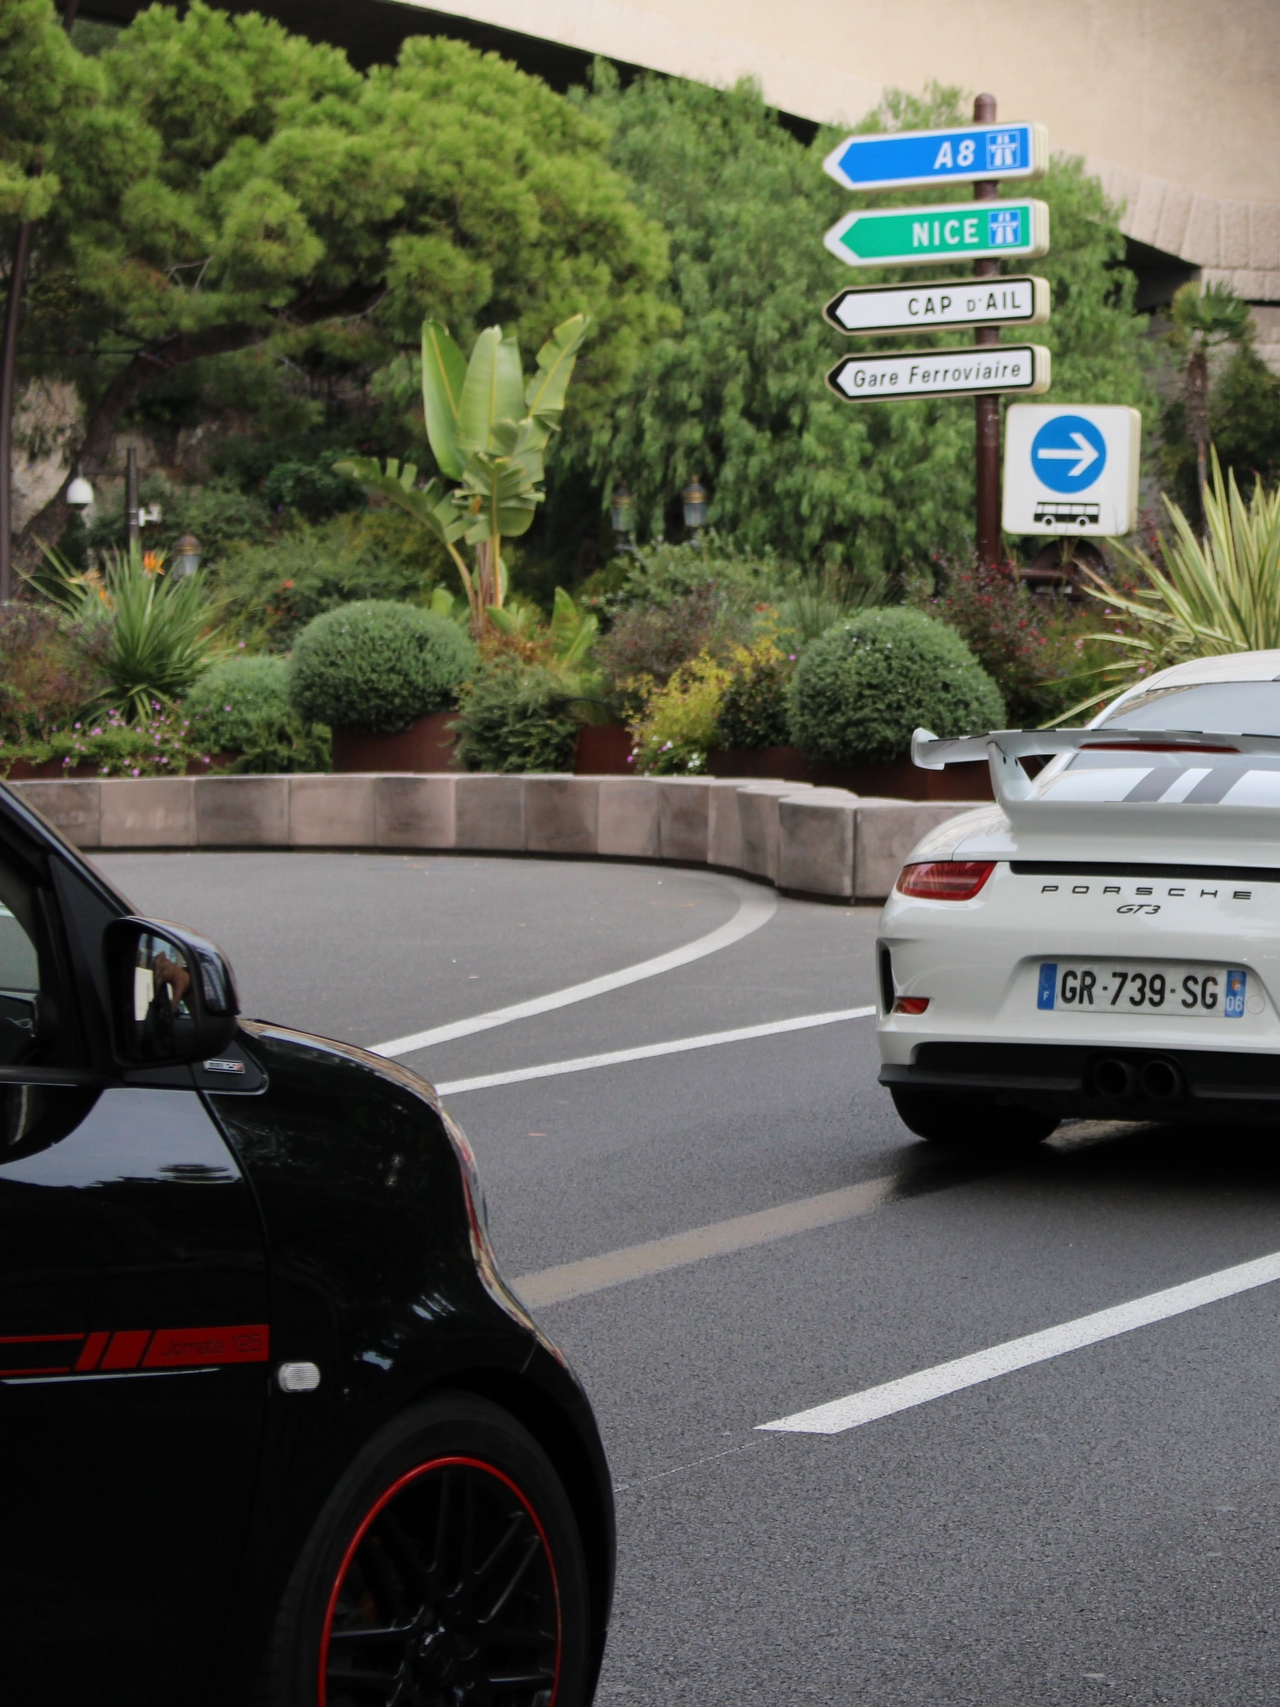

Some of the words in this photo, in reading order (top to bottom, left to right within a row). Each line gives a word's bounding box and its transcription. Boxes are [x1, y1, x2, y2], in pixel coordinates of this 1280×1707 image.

[933, 139, 976, 170] A8
[912, 218, 980, 248] NICE
[908, 296, 953, 317] CAP
[853, 367, 898, 388] Gare
[909, 362, 1021, 385] Ferroviaire
[1041, 885, 1252, 900] PORSCHE
[1116, 904, 1161, 915] GT3
[1043, 991, 1049, 1001] F
[1225, 995, 1244, 1012] 06
